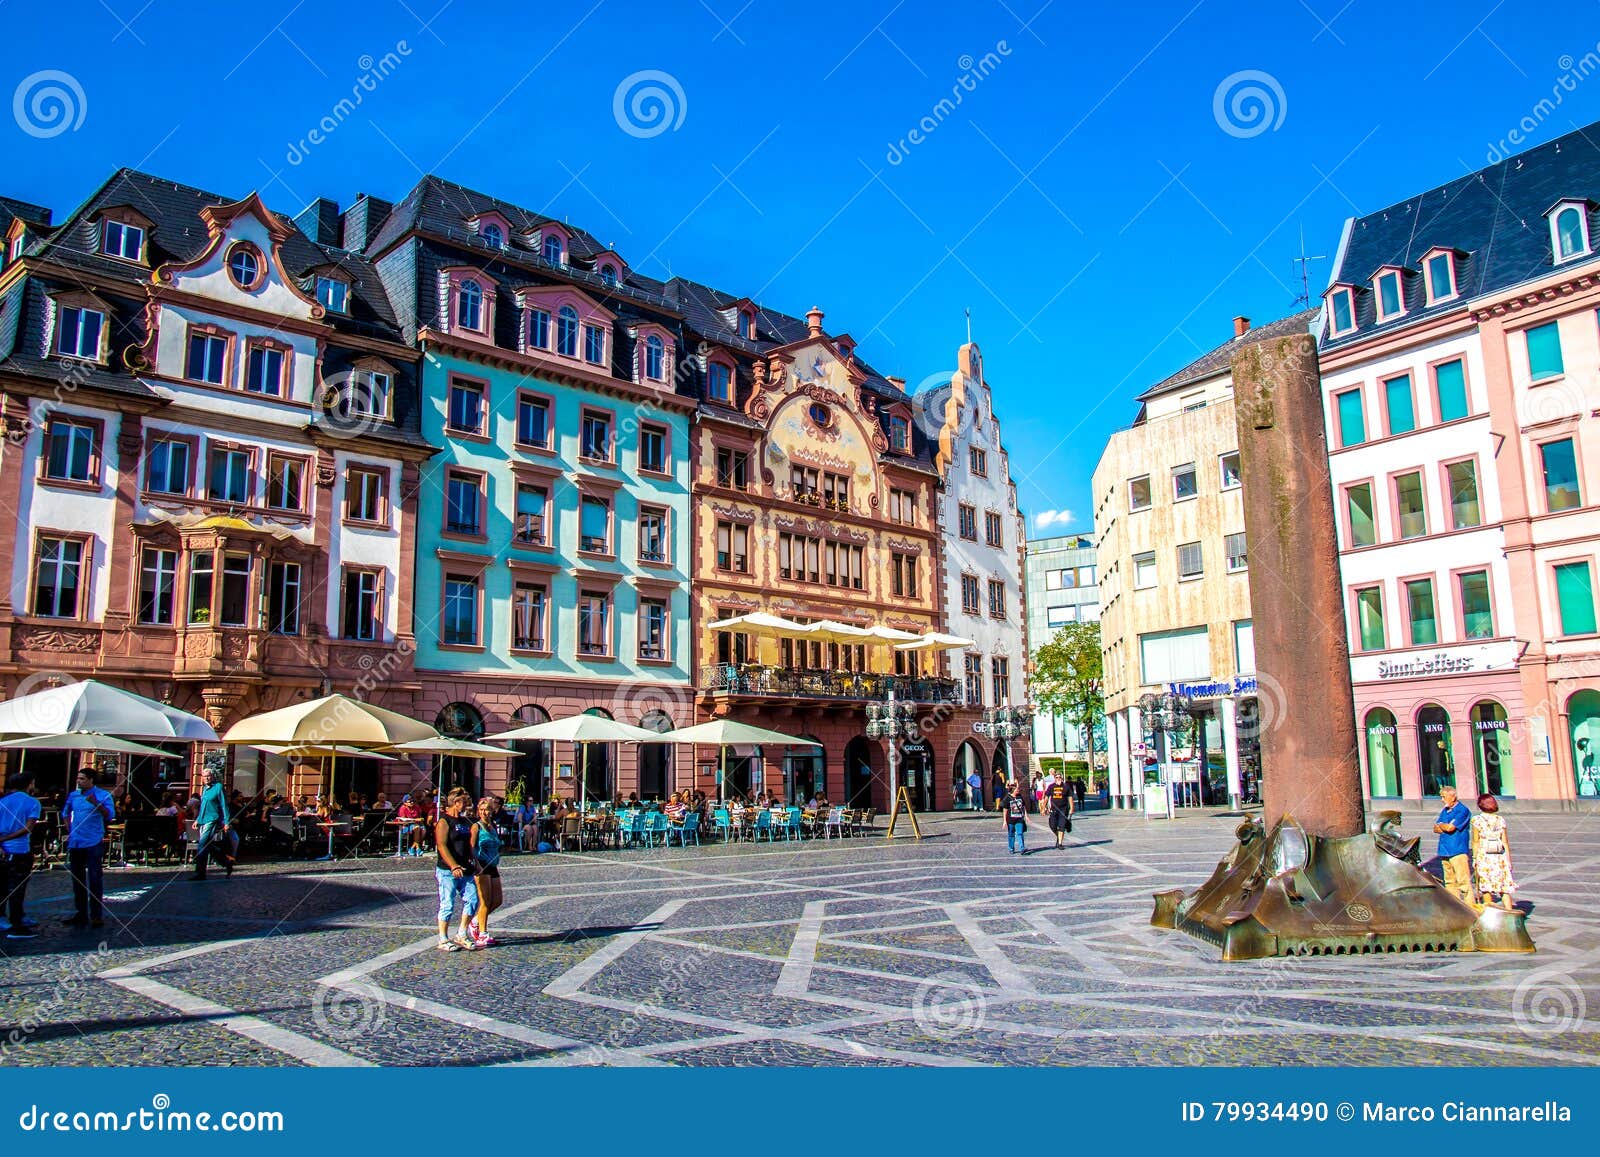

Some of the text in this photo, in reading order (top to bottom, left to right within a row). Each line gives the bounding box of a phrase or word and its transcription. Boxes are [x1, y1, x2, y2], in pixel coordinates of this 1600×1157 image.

[1234, 677, 1258, 696] Zeit
[1425, 724, 1444, 733] MNG
[1475, 720, 1506, 730] MANGO
[1369, 726, 1396, 735] MANGO
